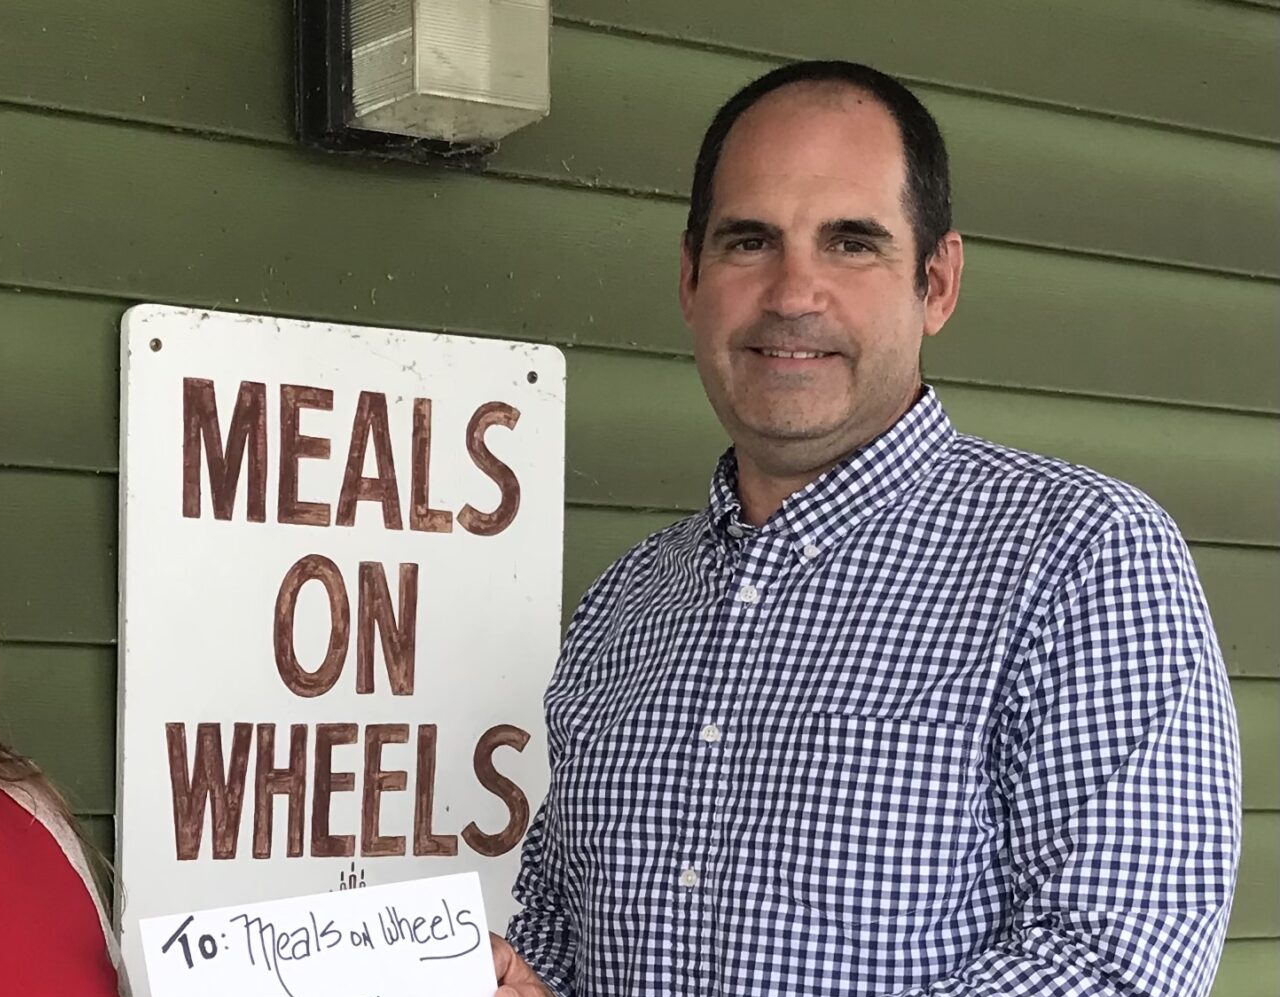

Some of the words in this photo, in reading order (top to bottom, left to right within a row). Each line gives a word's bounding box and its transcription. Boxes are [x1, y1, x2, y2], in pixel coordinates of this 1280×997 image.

[182, 377, 521, 536] MEALS
[273, 553, 419, 697] ON
[165, 722, 531, 860] WHEELS
[161, 915, 230, 969] To:
[378, 899, 481, 962] Wheels
